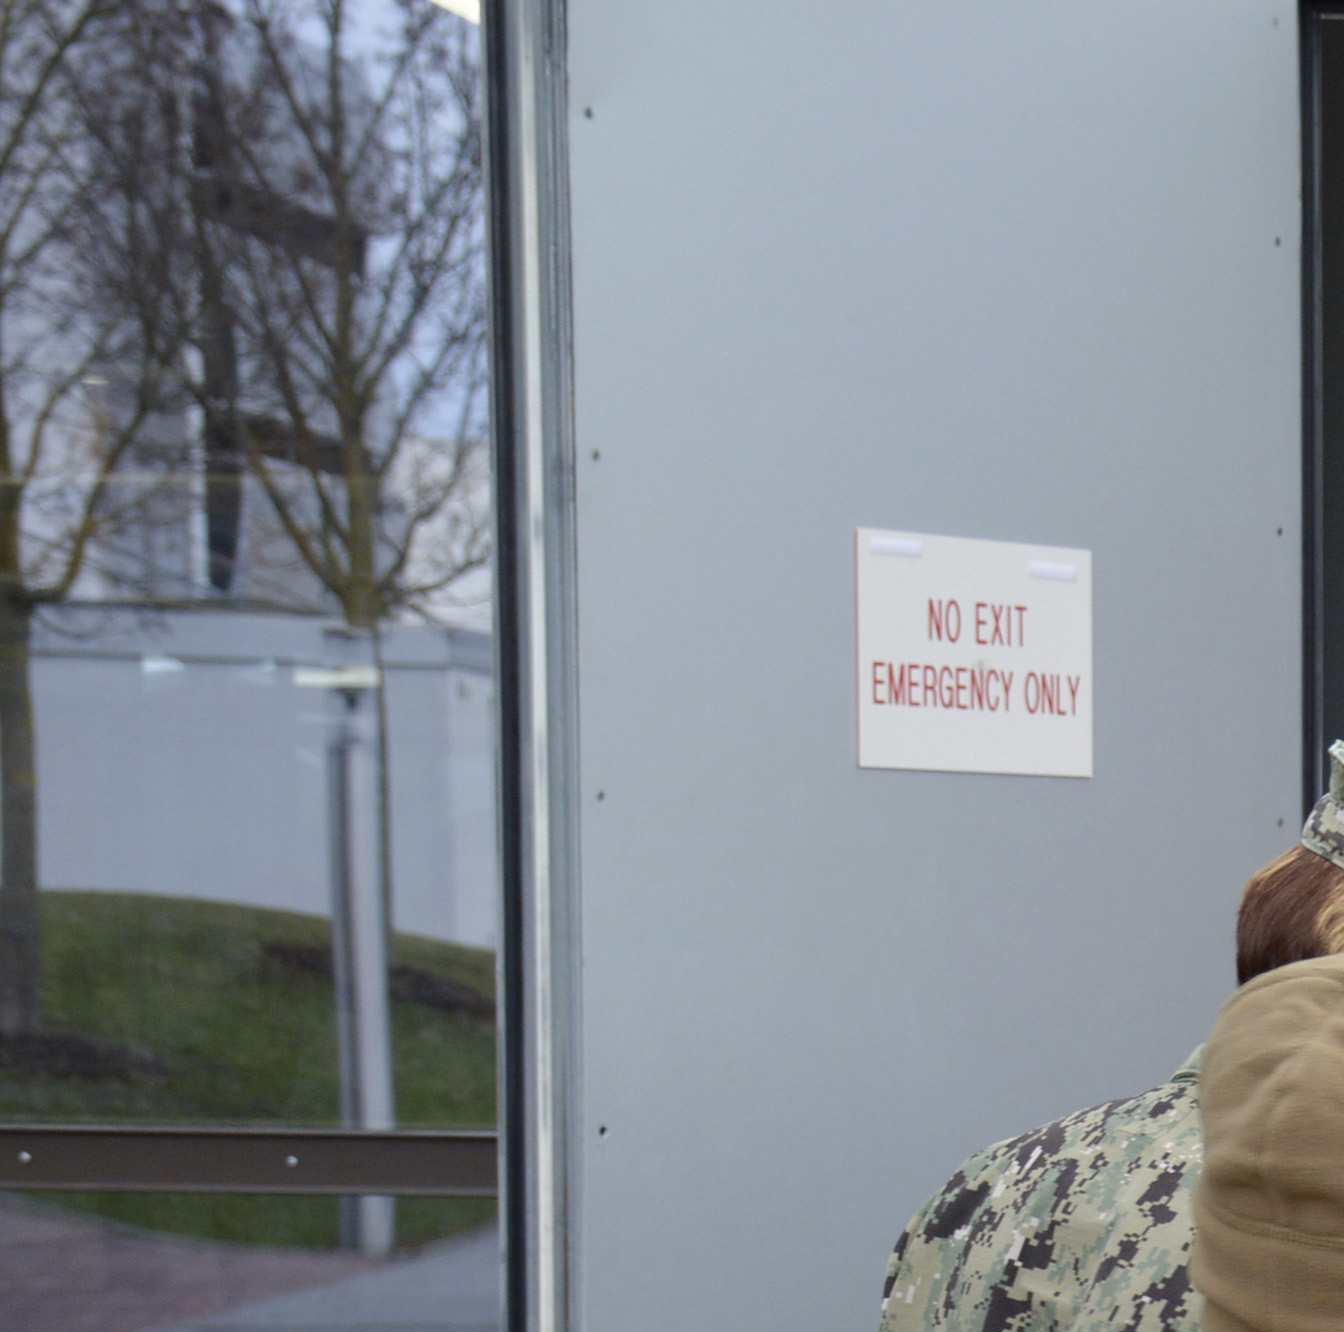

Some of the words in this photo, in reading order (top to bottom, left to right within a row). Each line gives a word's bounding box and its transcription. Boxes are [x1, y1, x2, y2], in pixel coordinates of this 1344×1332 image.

[928, 598, 961, 643] NO
[975, 602, 1028, 647] EXIT
[872, 661, 1014, 712] EMERGENCY
[1024, 671, 1080, 716] ONLY
